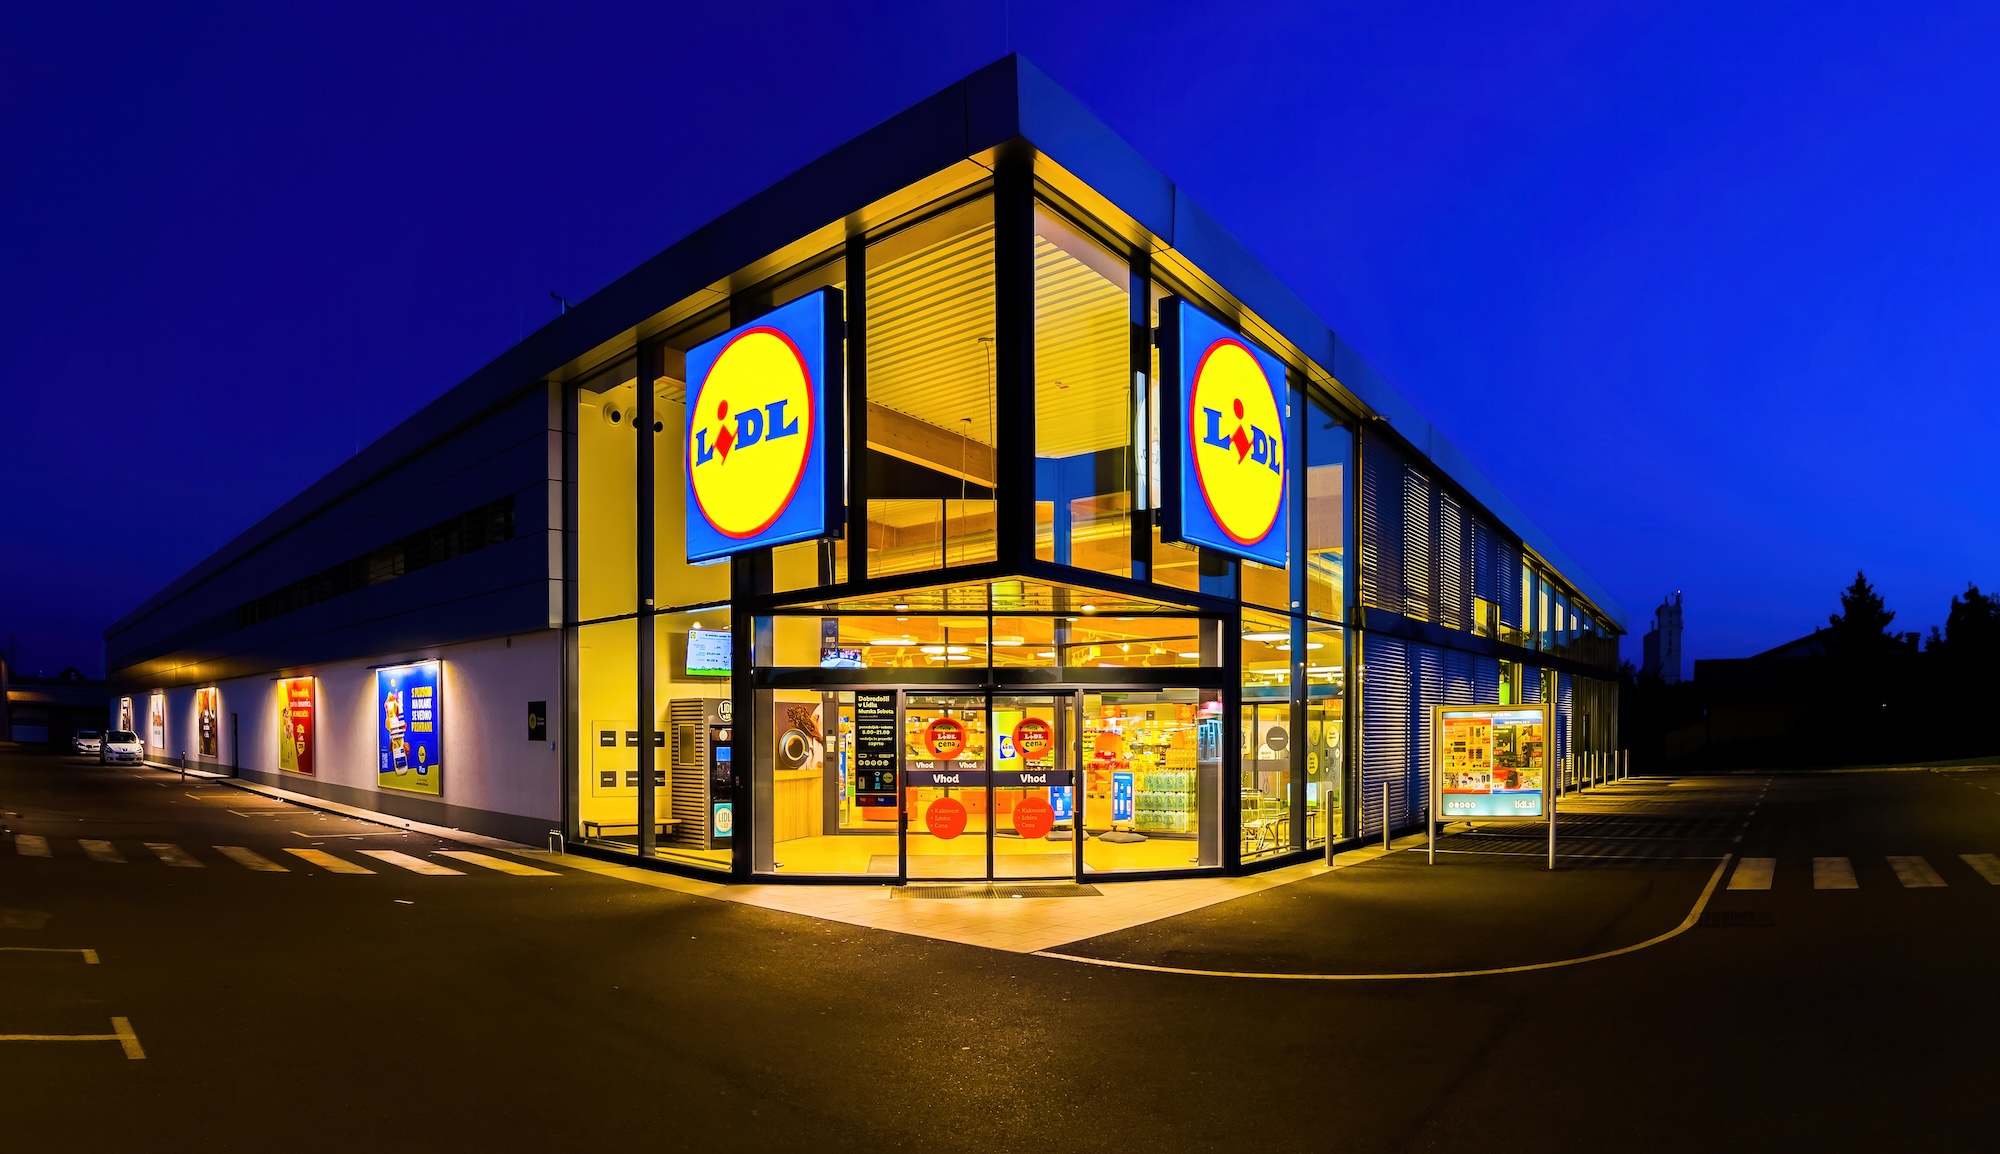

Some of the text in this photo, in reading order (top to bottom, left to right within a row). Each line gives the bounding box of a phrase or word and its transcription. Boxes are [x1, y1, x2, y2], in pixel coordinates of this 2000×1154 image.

[695, 399, 799, 466] LIDL
[1203, 398, 1281, 476] LIDL
[933, 774, 960, 783] Vhod
[1020, 774, 1047, 783] Vhod
[718, 812, 731, 823] LIDL
